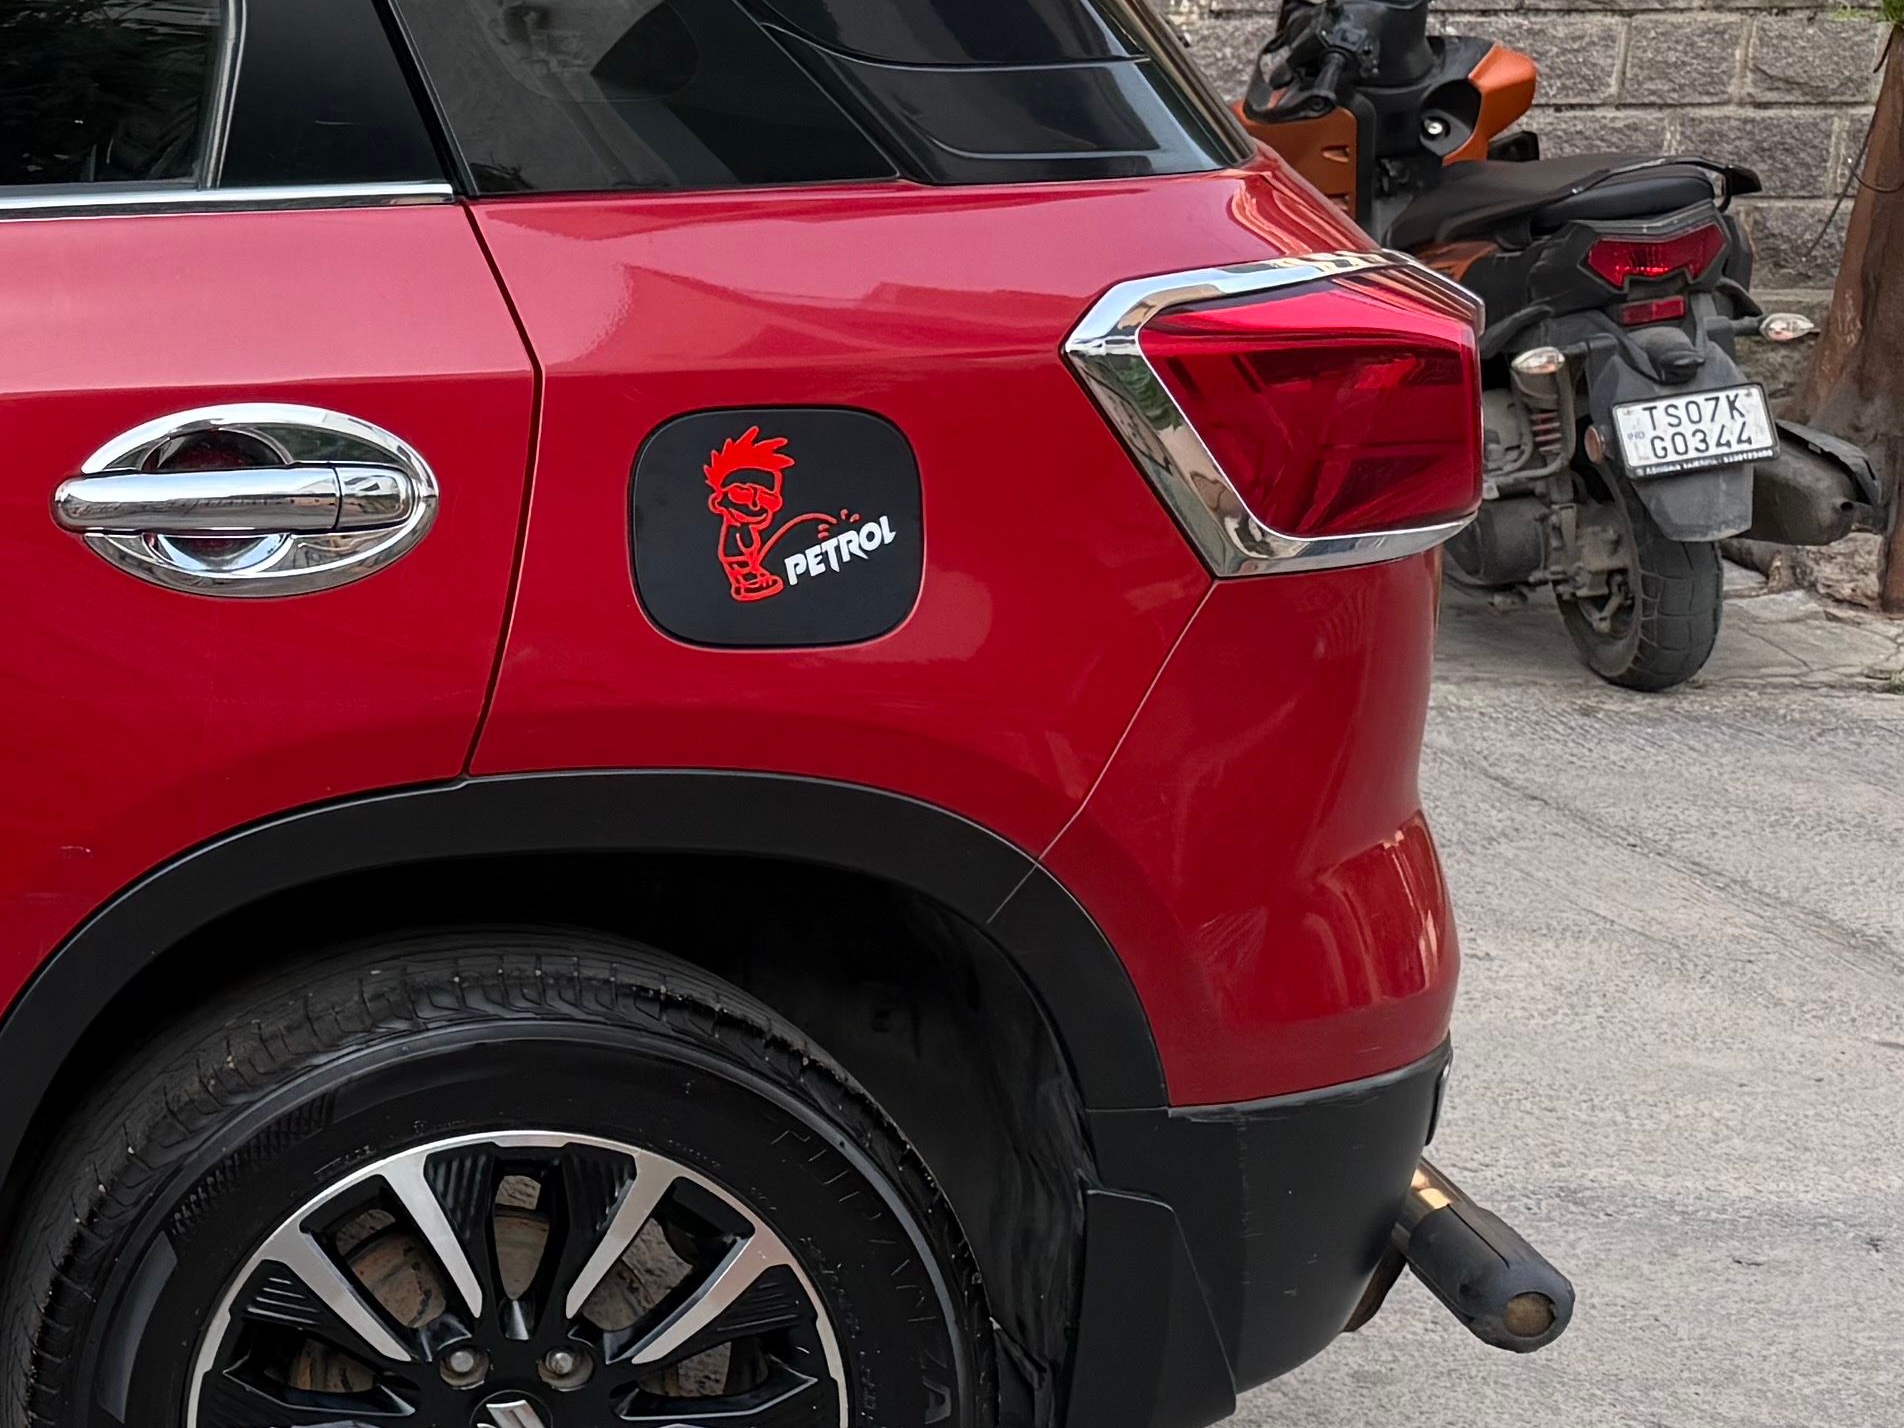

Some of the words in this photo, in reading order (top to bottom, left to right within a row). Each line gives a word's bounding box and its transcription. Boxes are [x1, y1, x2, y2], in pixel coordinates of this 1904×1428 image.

[1641, 393, 1746, 431] TS07K
[1650, 420, 1753, 459] G0344
[784, 515, 897, 586] PETROL
